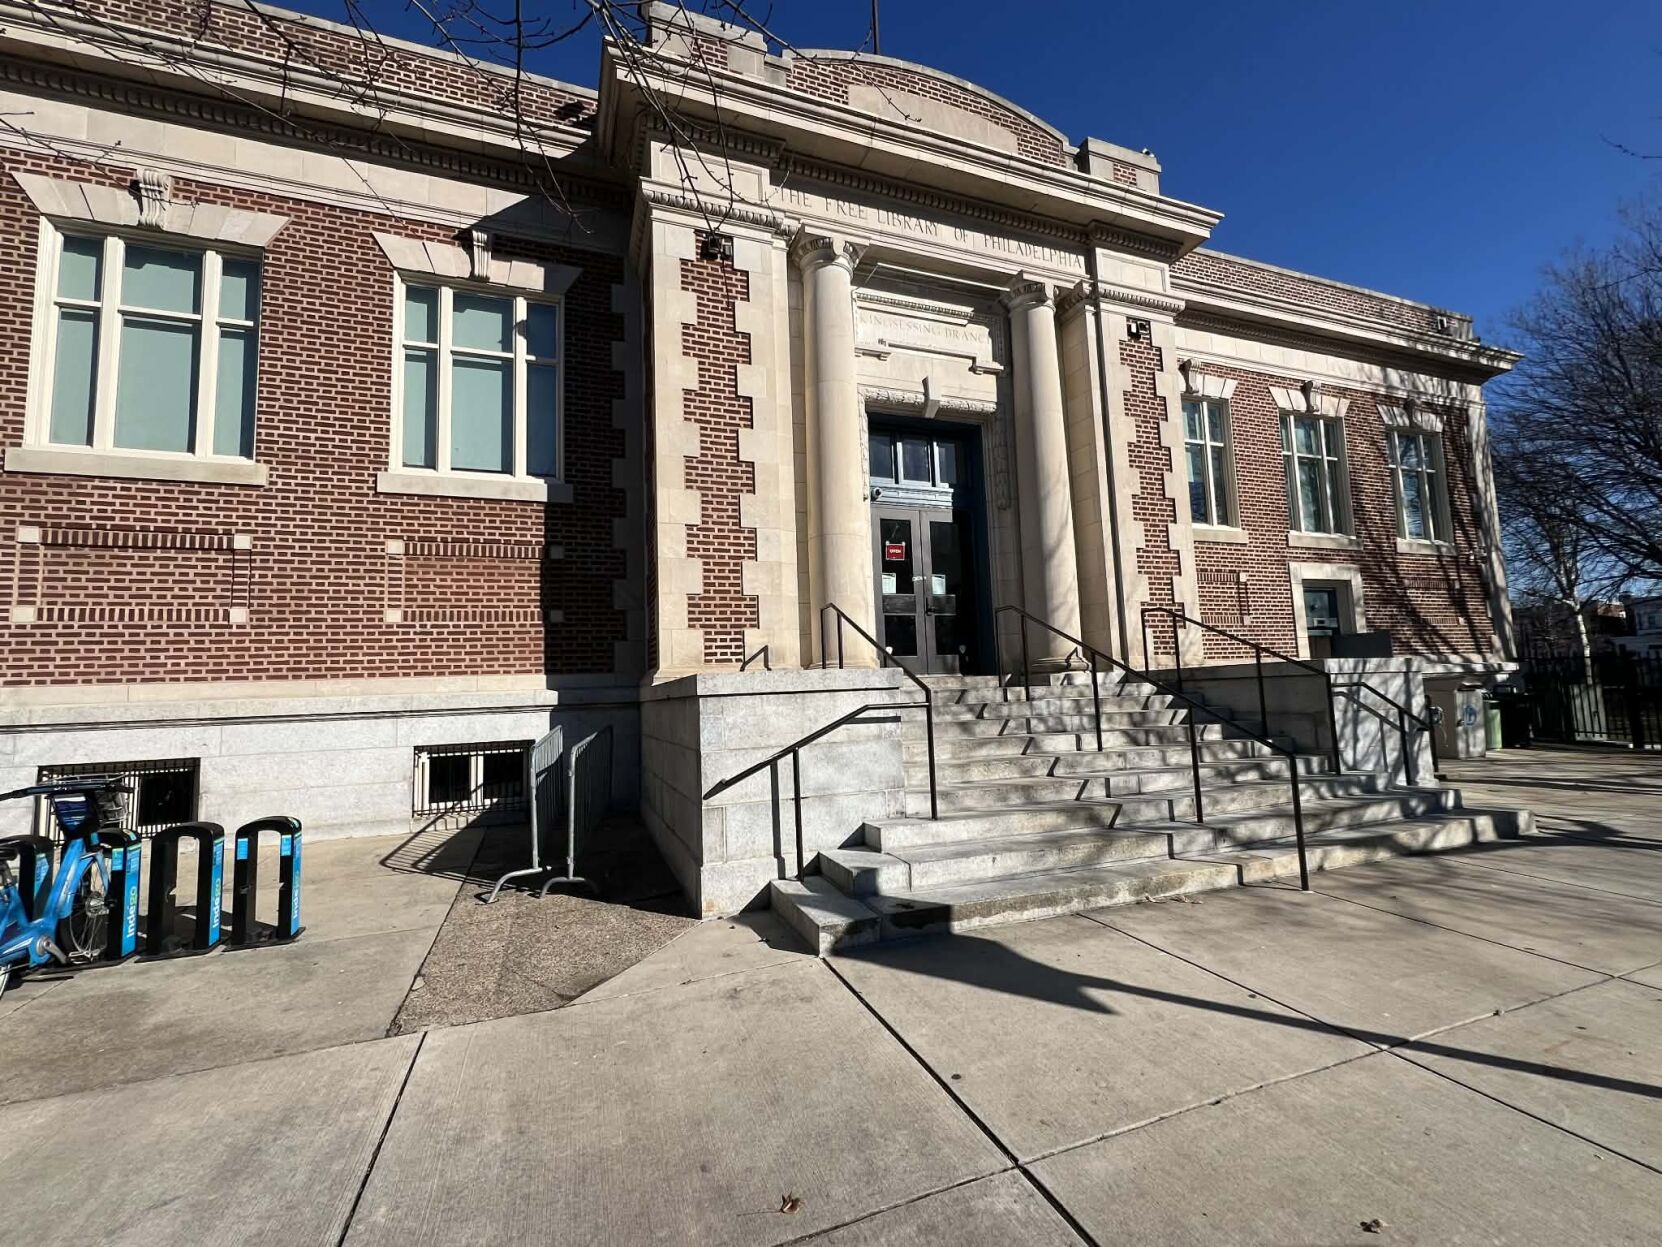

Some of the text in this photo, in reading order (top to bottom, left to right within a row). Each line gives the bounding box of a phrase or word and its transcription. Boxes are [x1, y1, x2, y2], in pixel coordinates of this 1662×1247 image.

[779, 186, 1082, 269] THE FREE LIBRARY OF PHILADELPHIA
